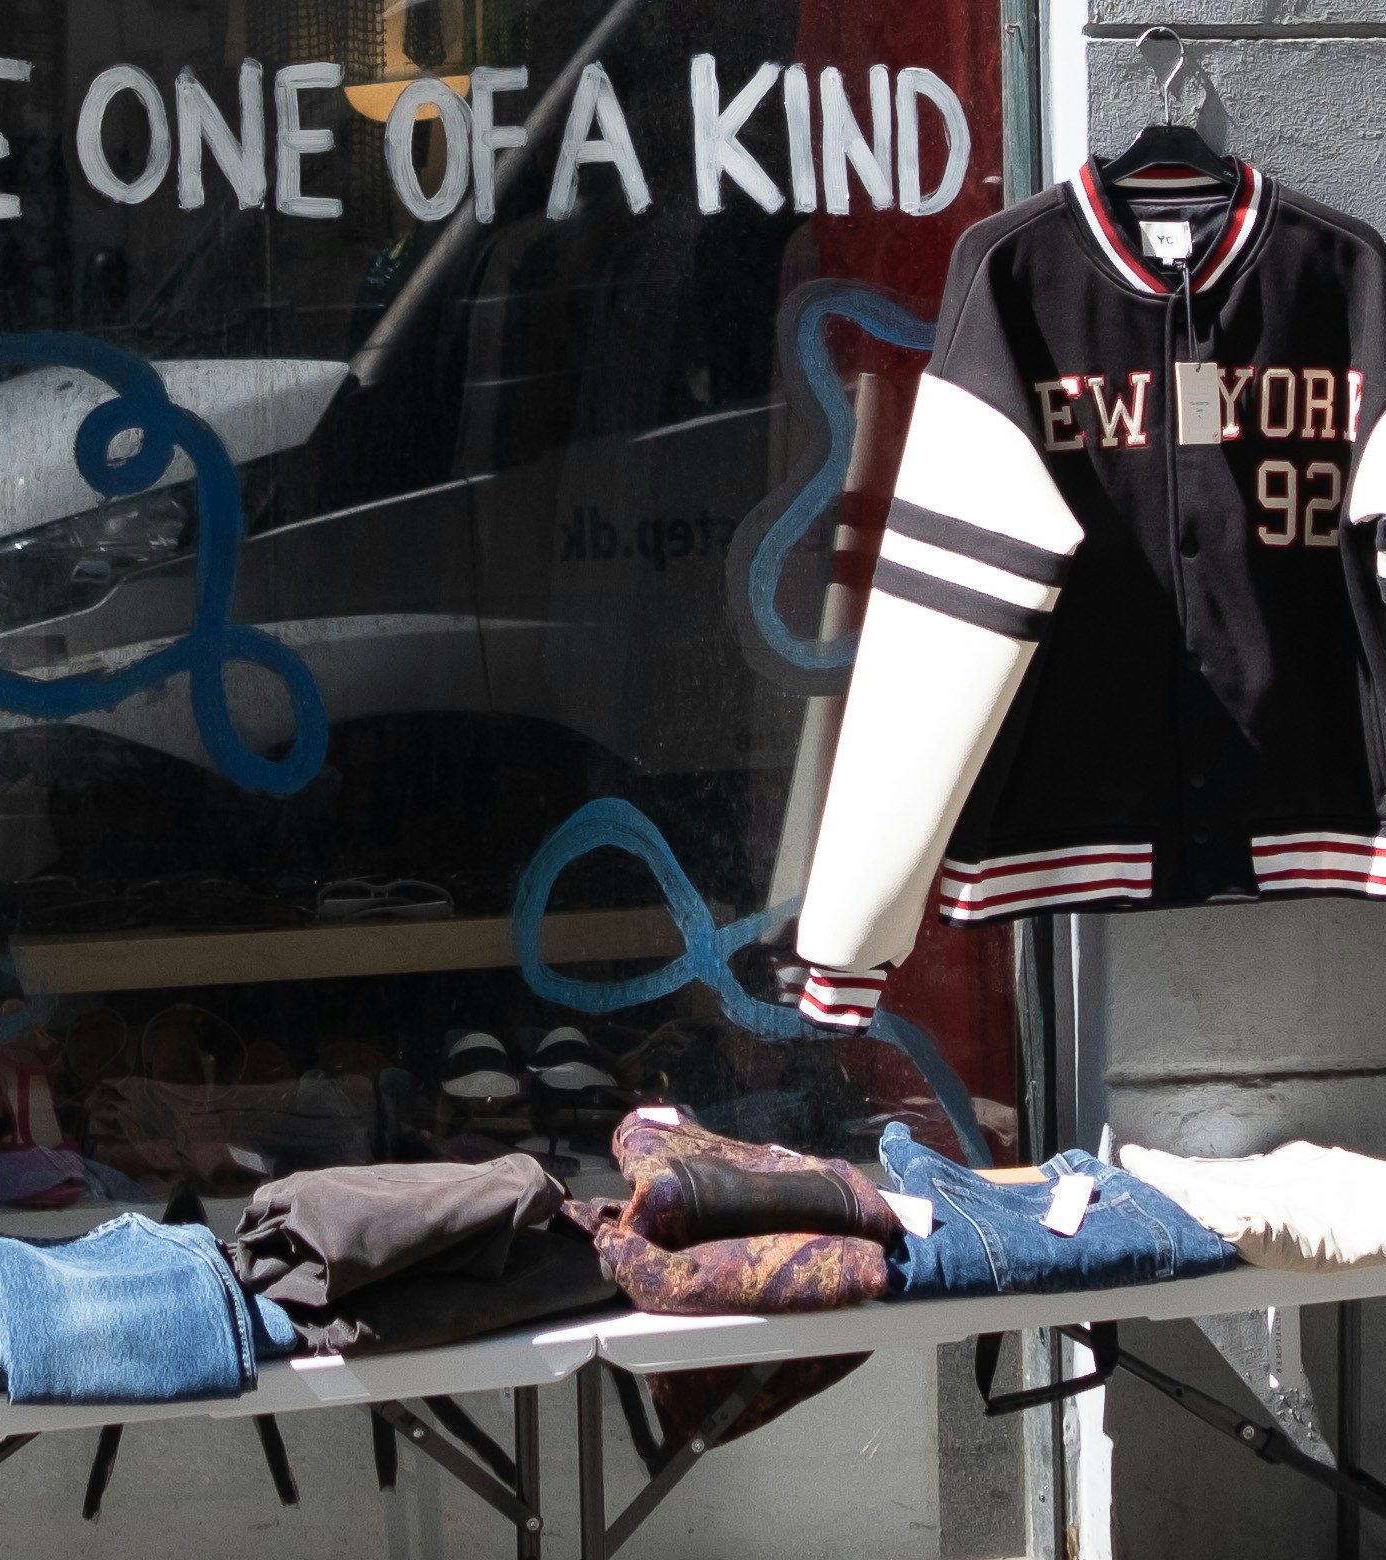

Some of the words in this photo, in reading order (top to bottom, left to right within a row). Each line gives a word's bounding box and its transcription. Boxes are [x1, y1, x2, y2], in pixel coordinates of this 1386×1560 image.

[76, 55, 345, 219] ONE
[383, 65, 530, 223] OF
[546, 61, 653, 221] A
[691, 53, 971, 217] KIND
[1257, 460, 1341, 546] 92
